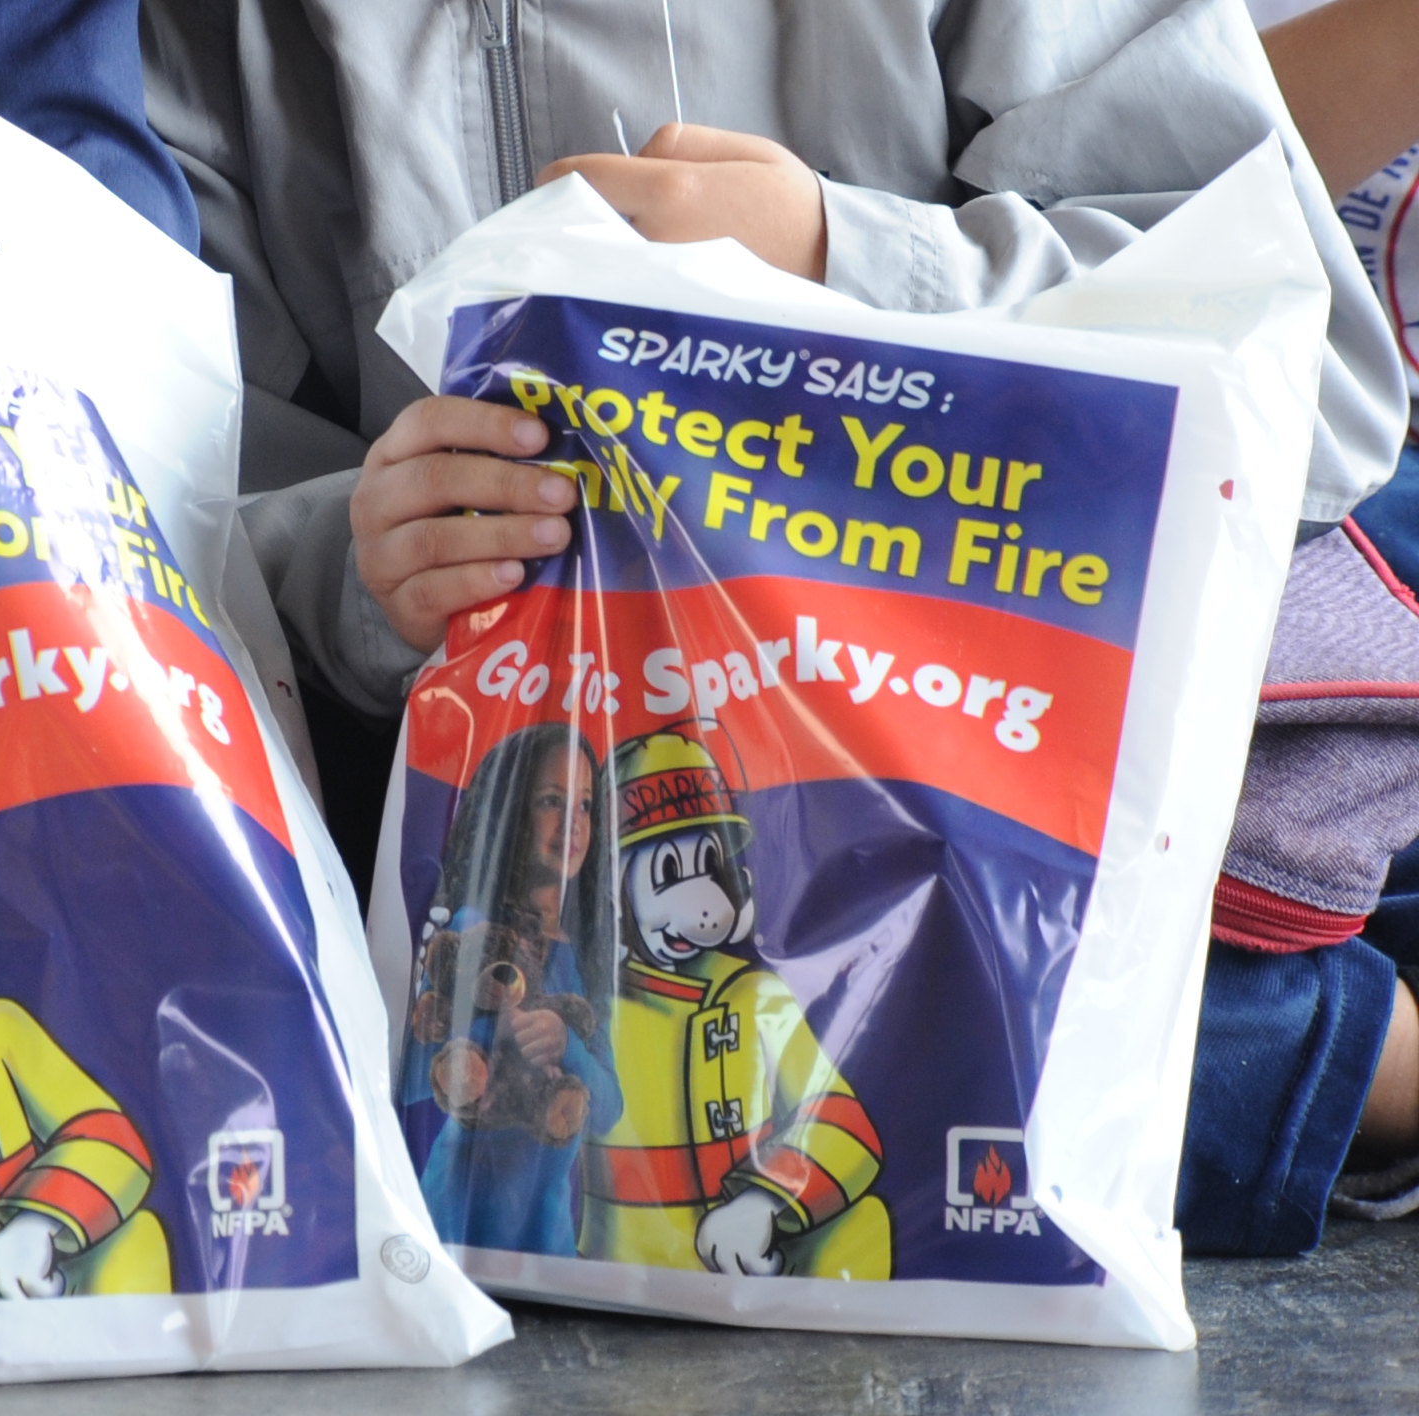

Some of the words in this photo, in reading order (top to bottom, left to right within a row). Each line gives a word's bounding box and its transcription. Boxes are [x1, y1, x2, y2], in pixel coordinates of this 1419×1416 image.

[509, 368, 814, 479] Protect
[841, 415, 1042, 512] Your
[704, 476, 923, 579] From
[947, 519, 1109, 607] Fire
[642, 615, 1053, 754] Sparky.org
[211, 1210, 290, 1239] NFPA
[945, 1206, 1041, 1237] NFPA
